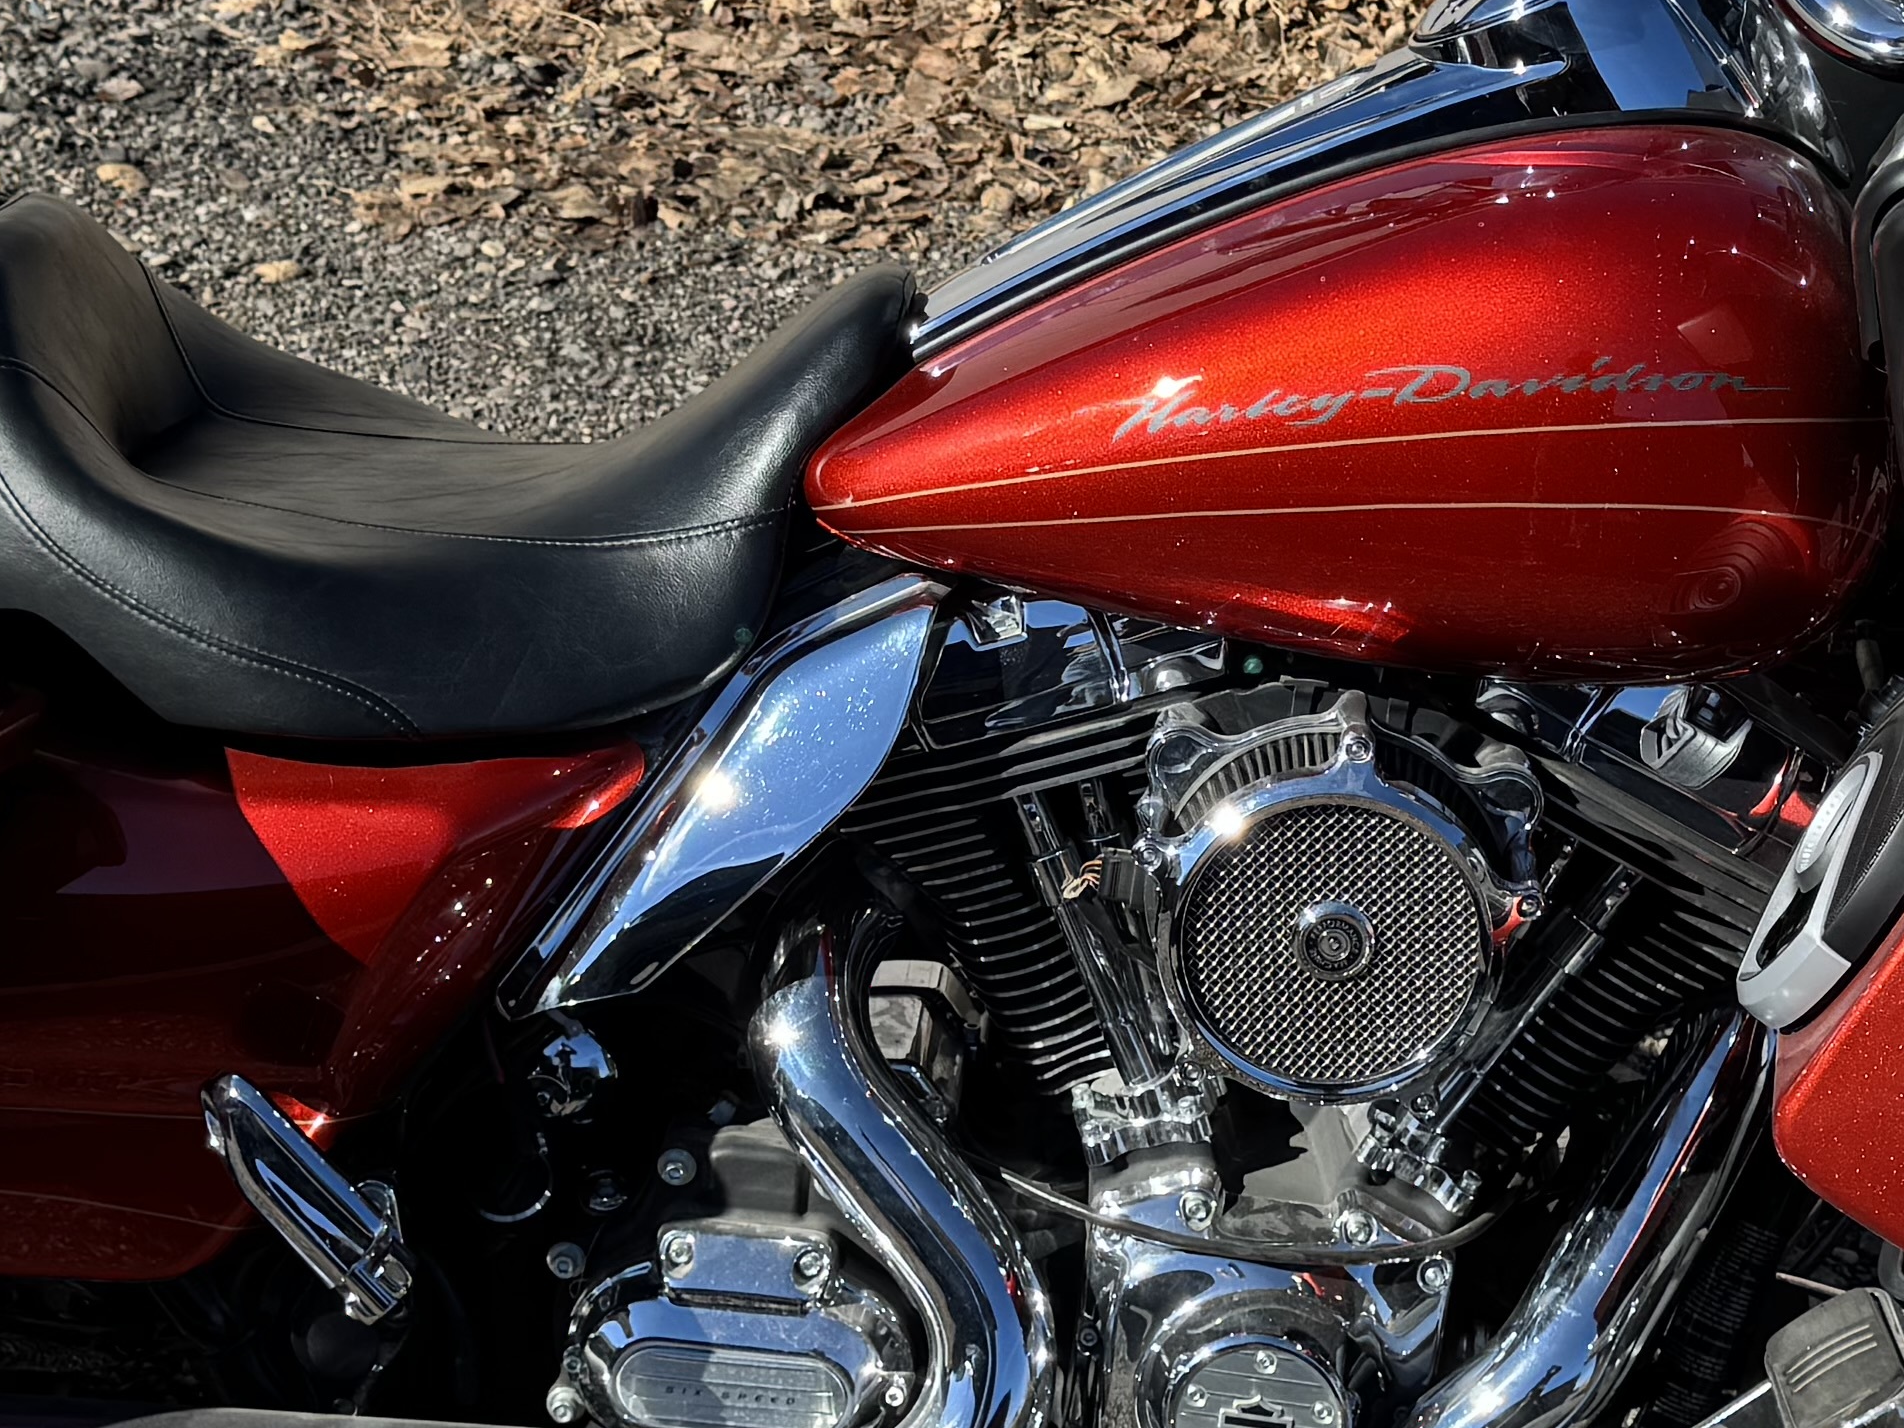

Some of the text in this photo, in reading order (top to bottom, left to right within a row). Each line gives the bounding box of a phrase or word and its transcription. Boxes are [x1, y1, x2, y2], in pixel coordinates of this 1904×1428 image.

[1112, 356, 1790, 443] Harley-Davidson
[664, 1385, 797, 1406] SIX SPEED
